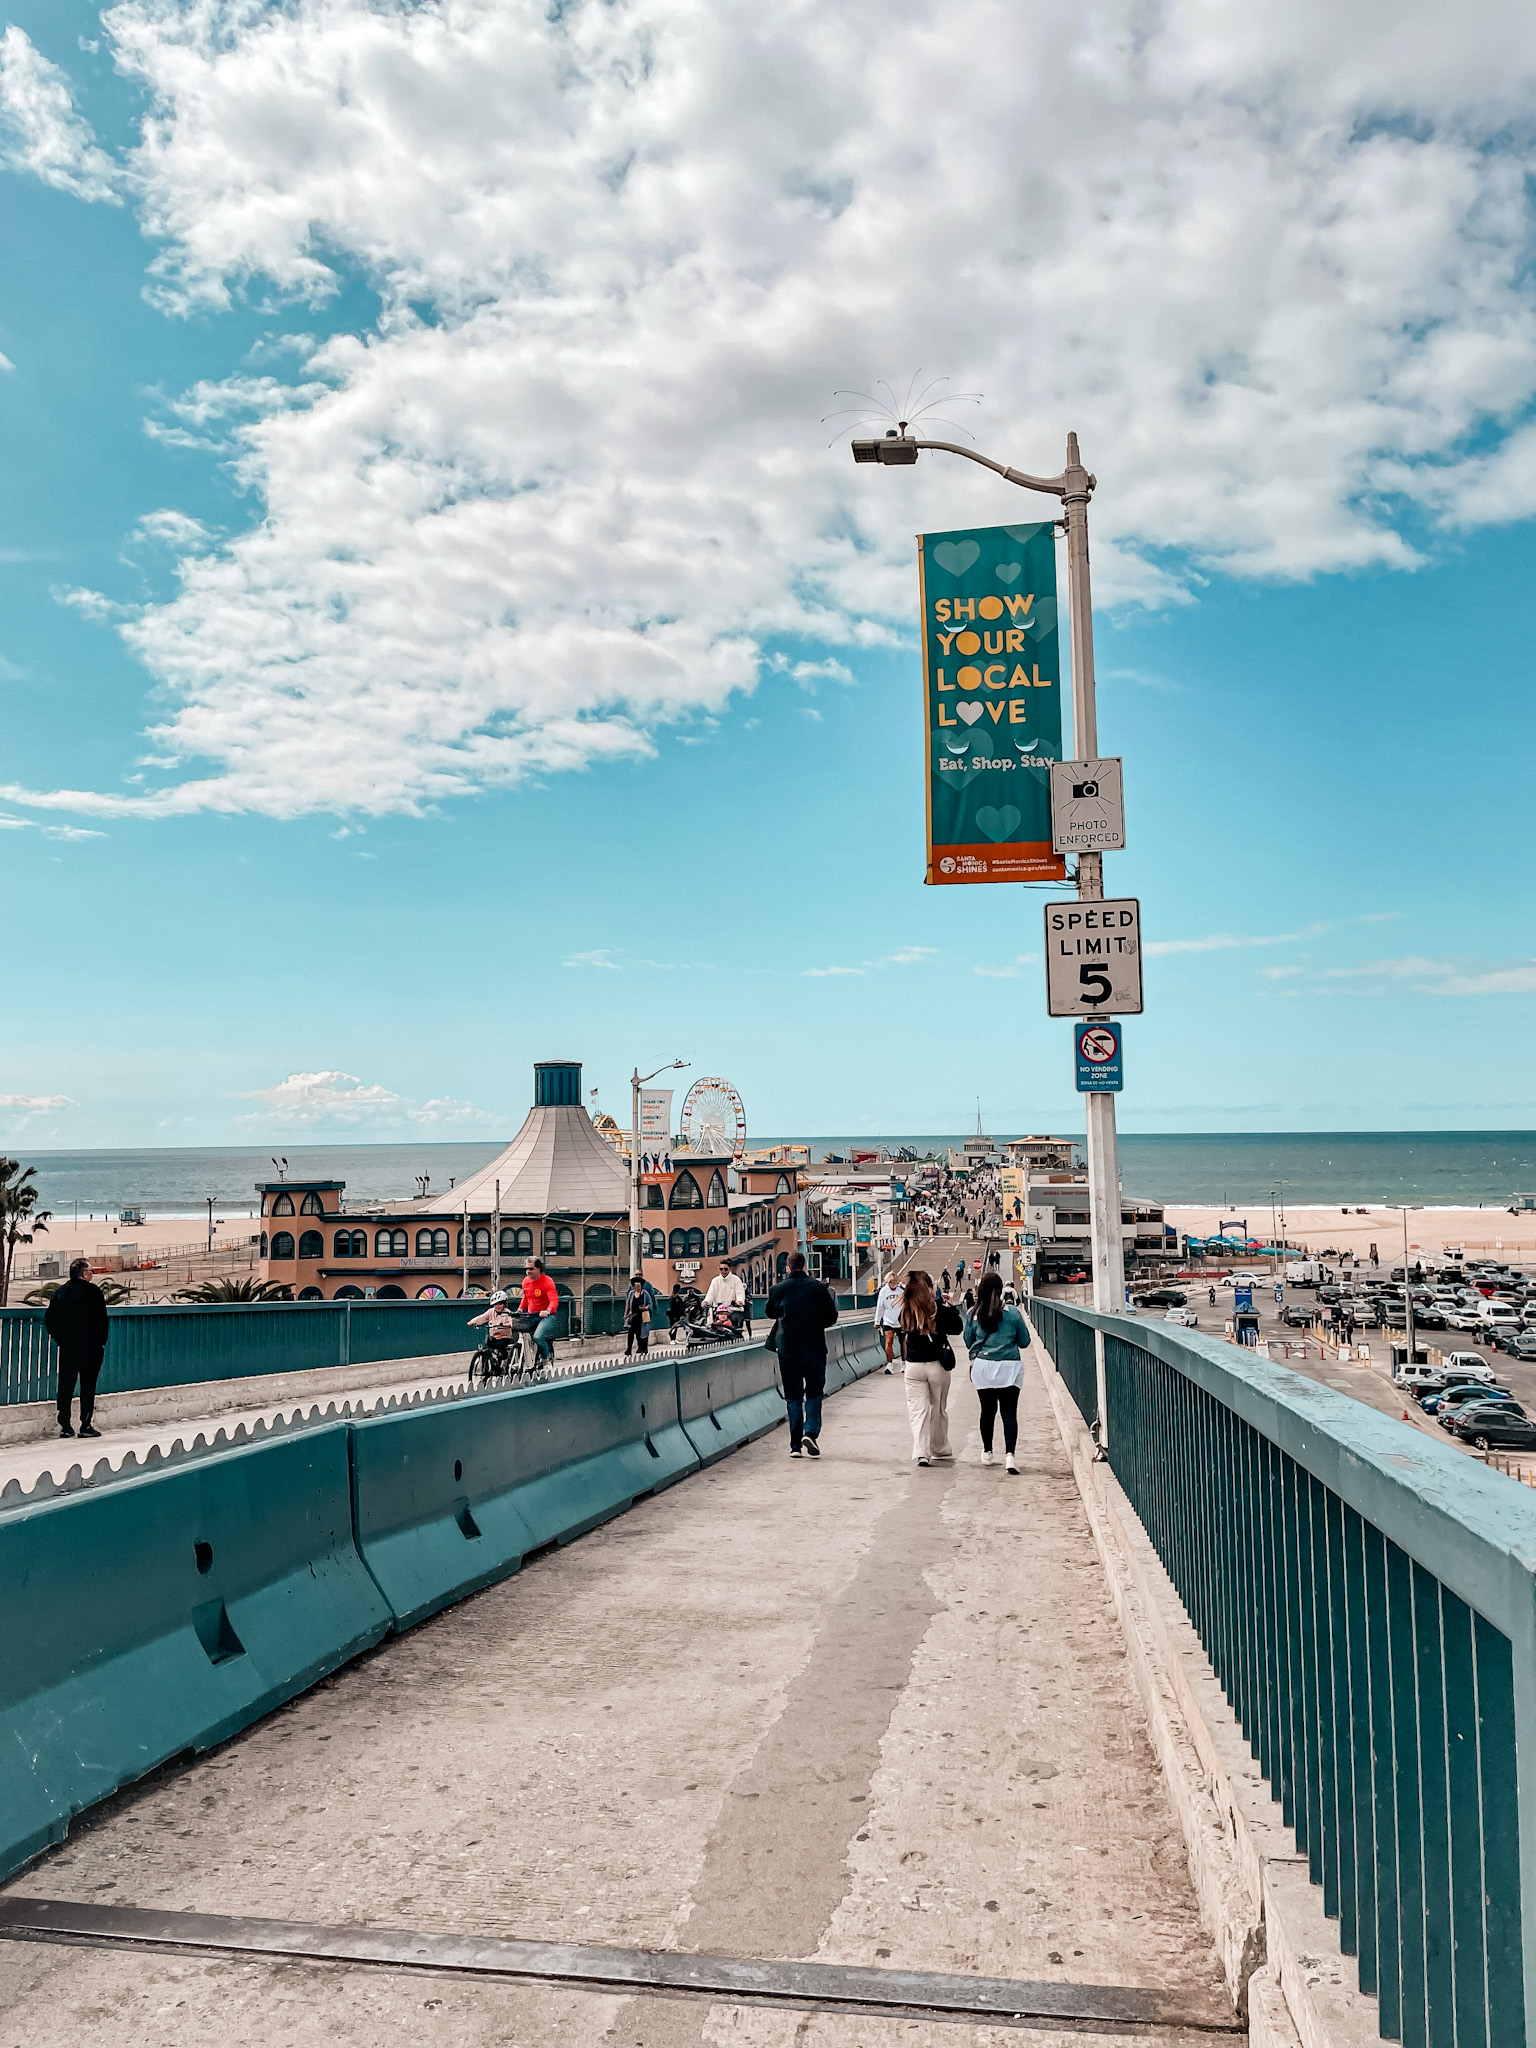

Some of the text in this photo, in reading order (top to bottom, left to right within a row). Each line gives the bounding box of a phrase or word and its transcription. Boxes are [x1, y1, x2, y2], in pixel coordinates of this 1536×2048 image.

[935, 593, 1035, 623] SHOW
[936, 629, 1026, 656] YOUR
[937, 663, 1052, 691] LOCAL
[939, 757, 968, 772] Eat,
[972, 756, 1016, 771] Shop,
[1069, 820, 1108, 831] PHOTO
[1059, 832, 1120, 845] ENFORCED
[956, 865, 988, 874] SHINES
[1052, 910, 1134, 930] SPEED
[1060, 937, 1127, 956] LIMIT
[1079, 962, 1113, 1005] 5
[400, 1257, 457, 1267] MERRY
[1276, 1292, 1282, 1301] 5
